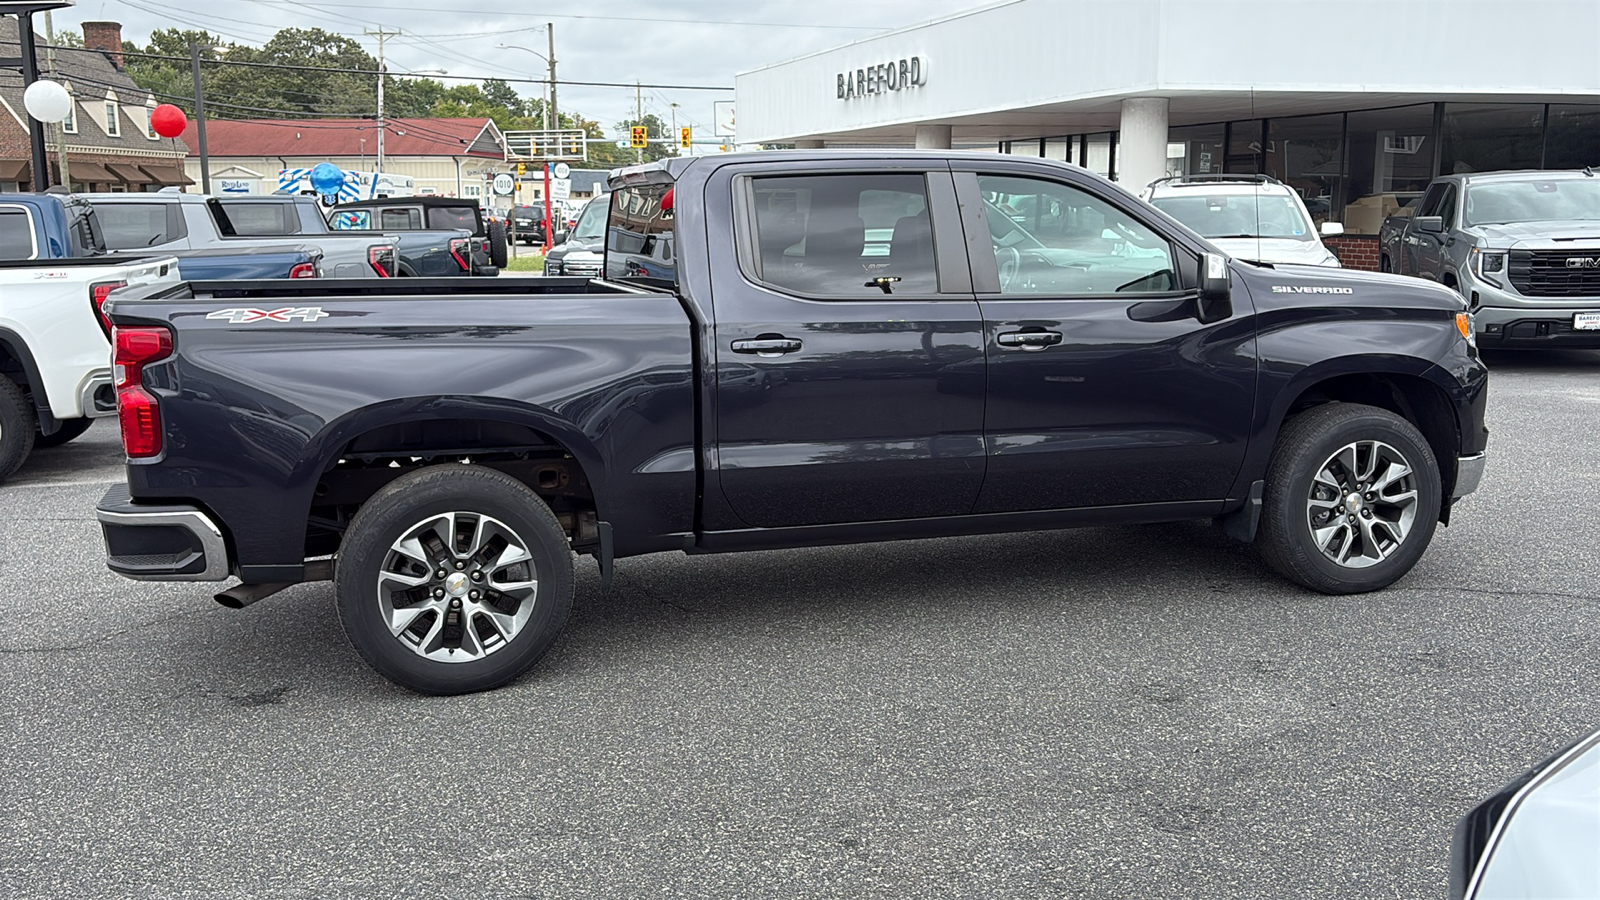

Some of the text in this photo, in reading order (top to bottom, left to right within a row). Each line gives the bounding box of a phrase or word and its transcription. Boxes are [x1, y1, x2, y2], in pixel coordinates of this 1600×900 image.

[837, 56, 920, 99] BAREFORD
[495, 180, 511, 189] 1010
[1271, 285, 1354, 295] SILVERADO
